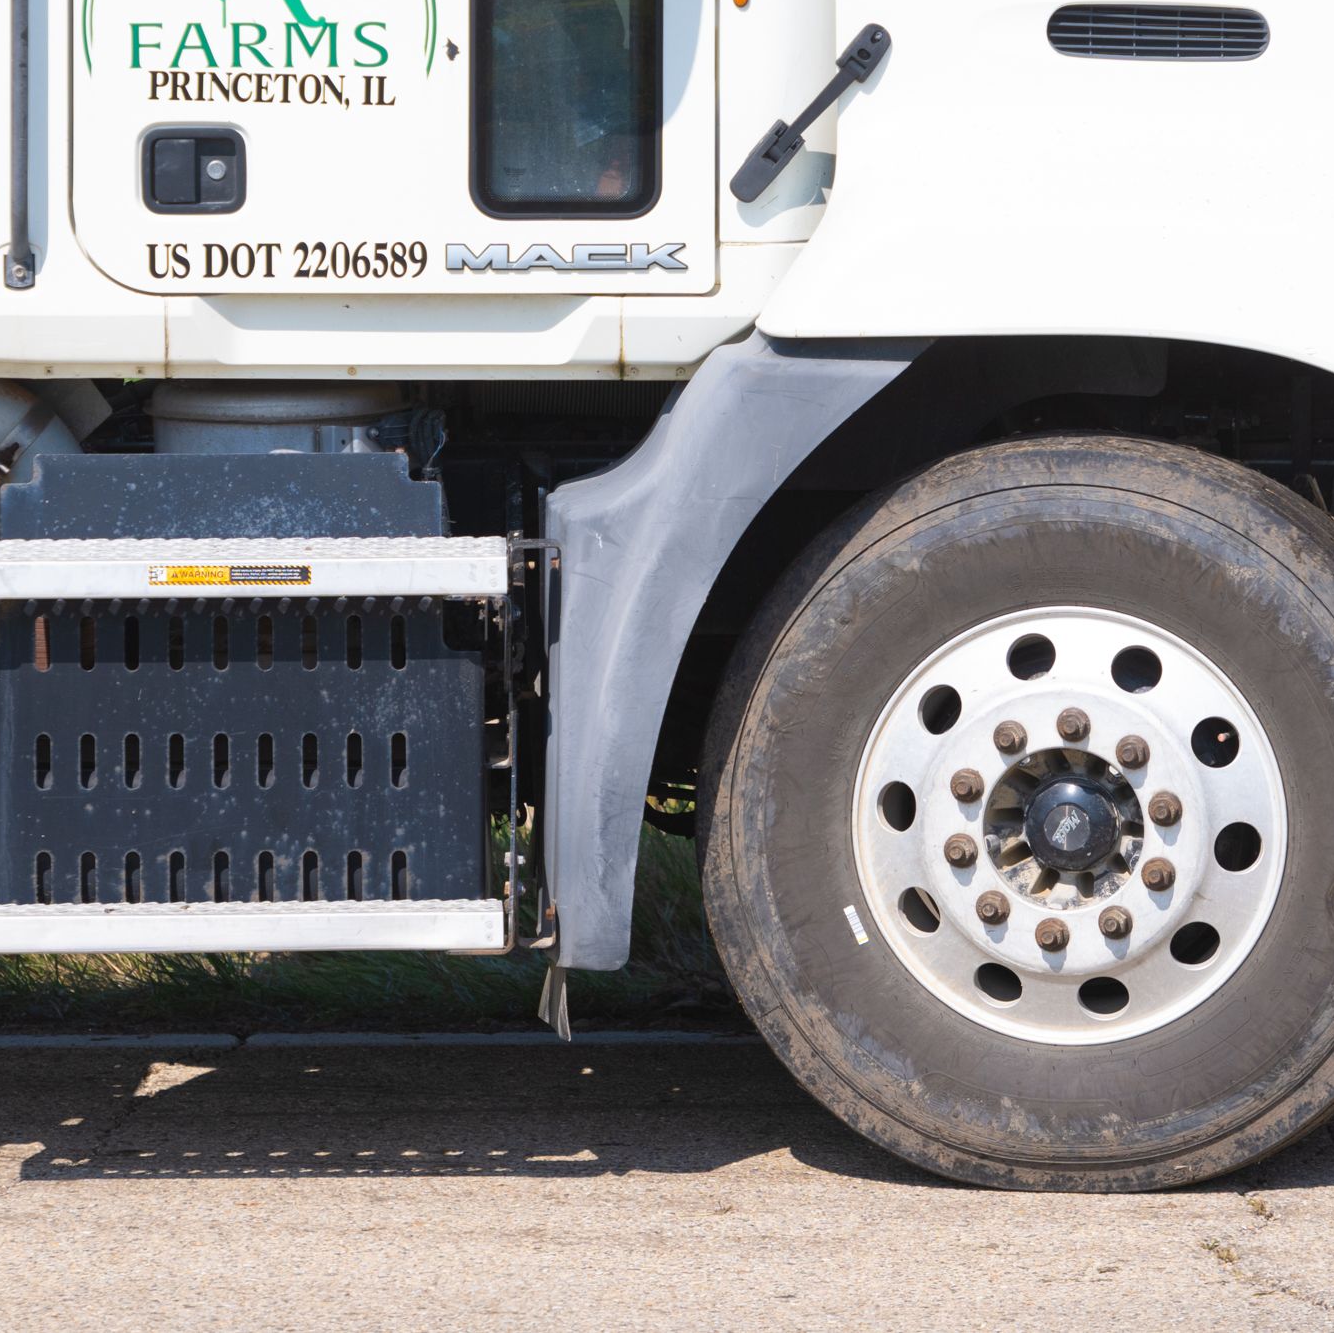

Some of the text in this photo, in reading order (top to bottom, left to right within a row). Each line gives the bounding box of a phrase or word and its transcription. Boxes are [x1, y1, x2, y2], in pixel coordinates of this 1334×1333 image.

[129, 21, 390, 69] FARMS
[148, 70, 397, 110] PRINCETON, IL
[146, 241, 428, 279] US DOT 2206589
[445, 243, 689, 271] MACK
[179, 570, 224, 578] WARNING
